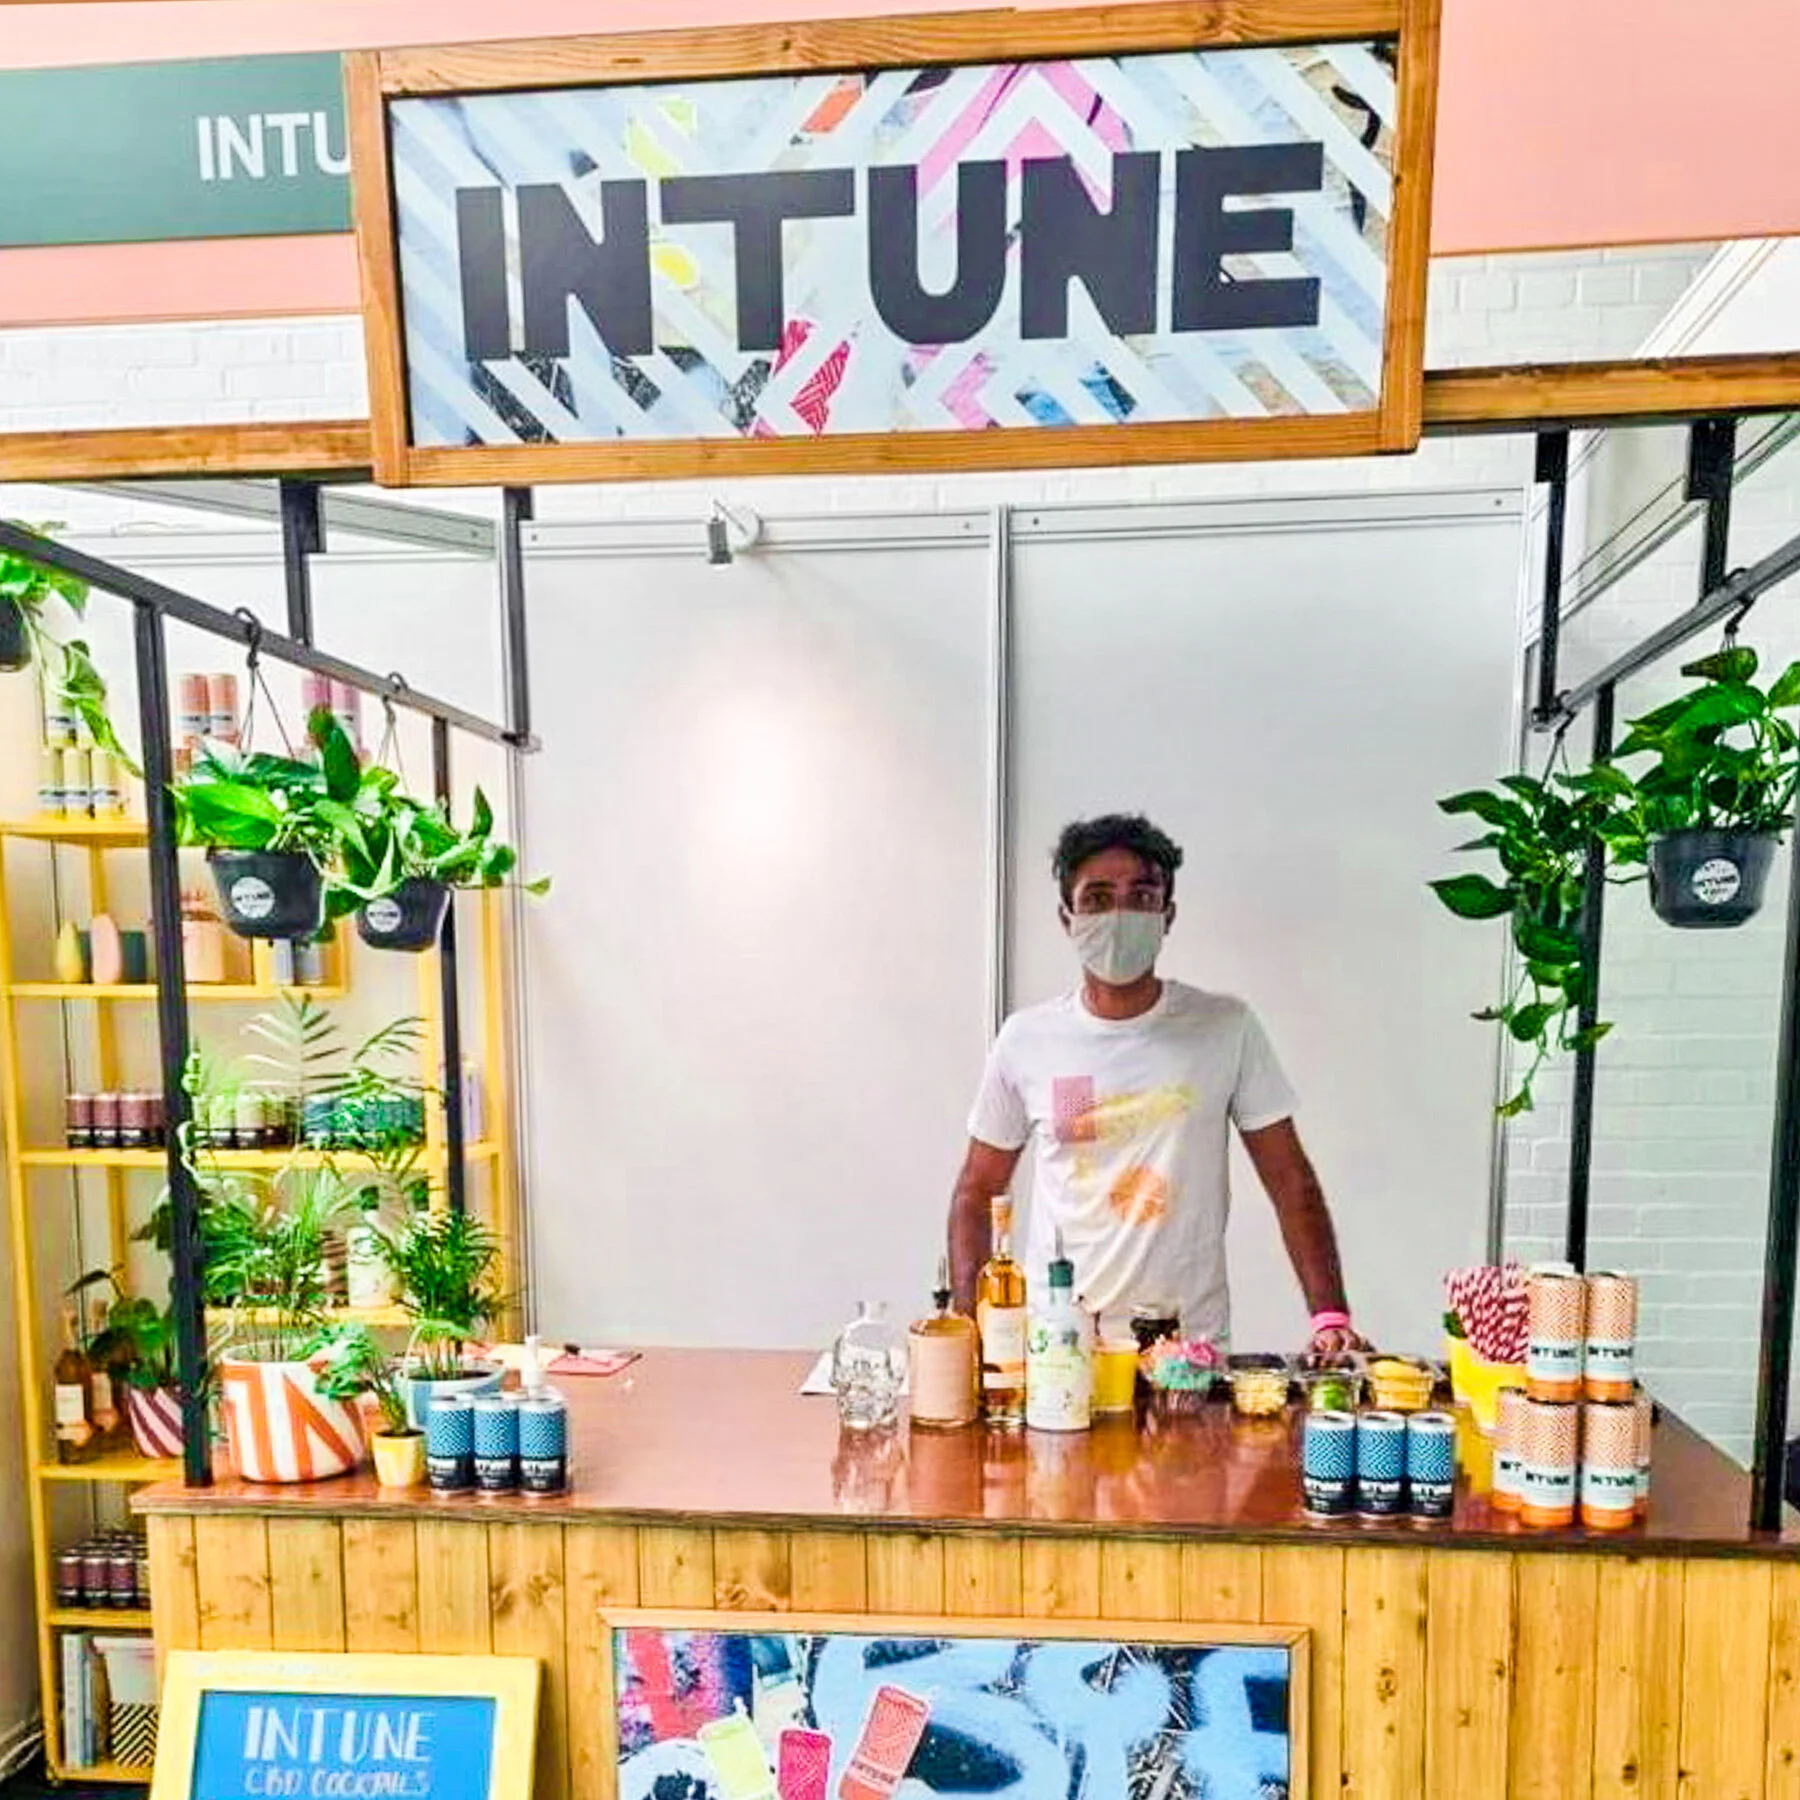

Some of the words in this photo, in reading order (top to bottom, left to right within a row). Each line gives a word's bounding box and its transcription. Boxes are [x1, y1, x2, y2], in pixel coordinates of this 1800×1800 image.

[198, 111, 352, 181] INTU
[454, 140, 1324, 361] INTUNE
[243, 1707, 436, 1763] INTUNE
